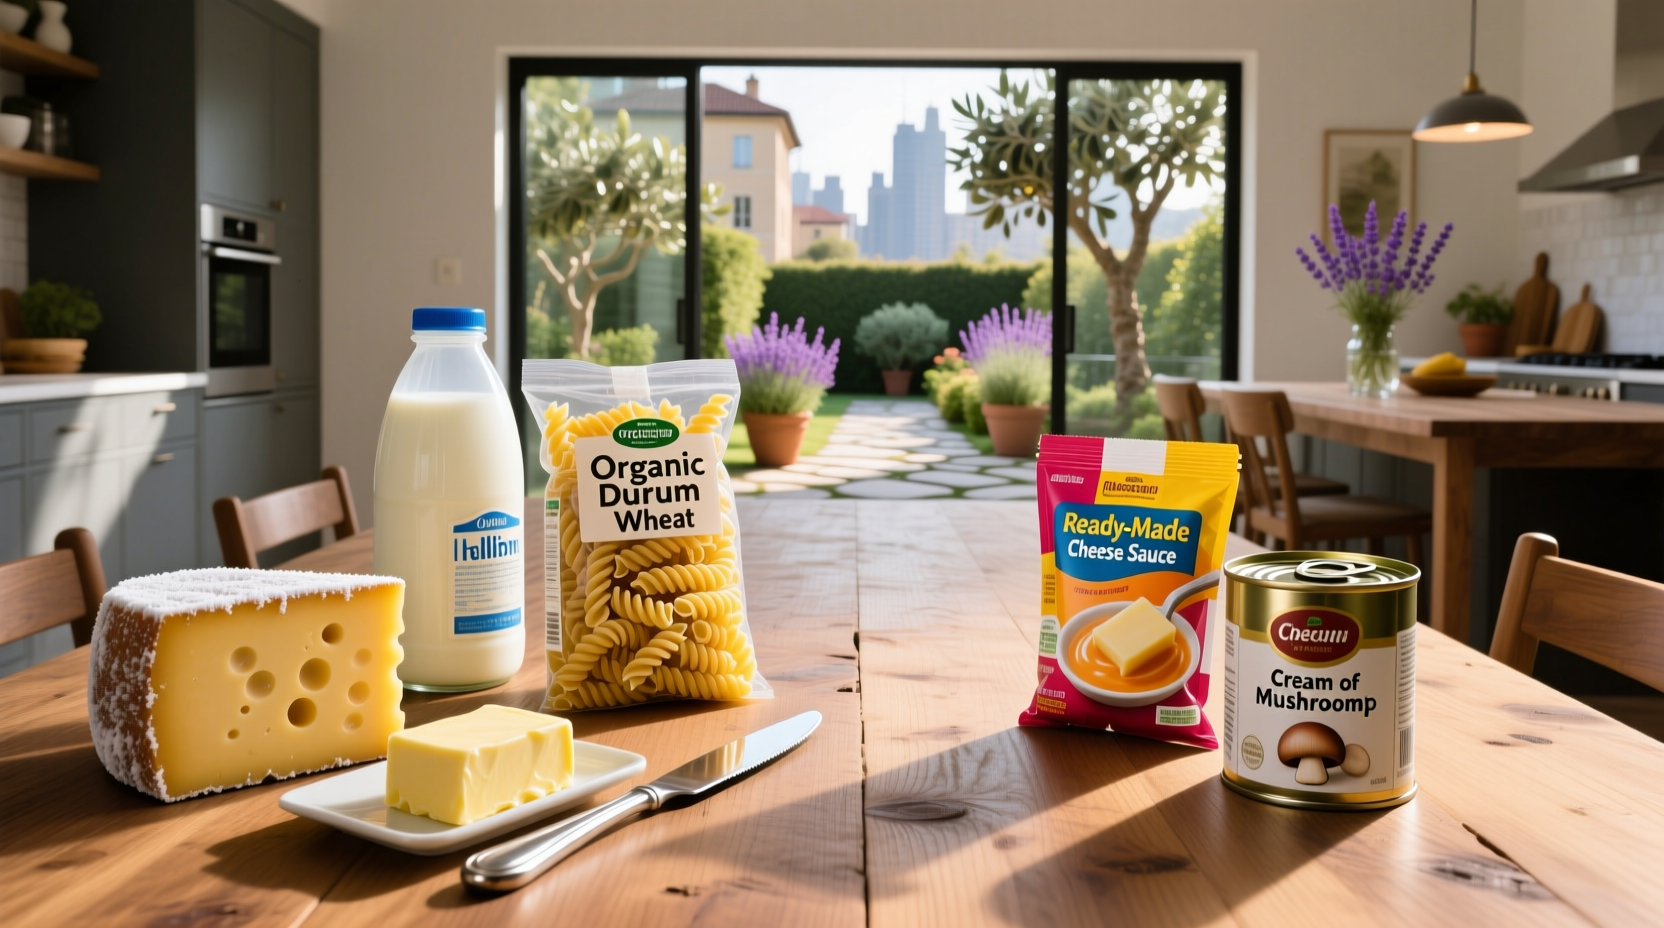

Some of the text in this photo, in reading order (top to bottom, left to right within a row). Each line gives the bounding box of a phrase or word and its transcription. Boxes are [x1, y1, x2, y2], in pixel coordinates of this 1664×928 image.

[590, 451, 706, 486] Organic
[599, 483, 700, 508] Durum
[614, 508, 695, 533] Wheat
[1063, 512, 1190, 543] Ready-Made
[1067, 539, 1177, 565] Cheese Sauce
[1271, 669, 1361, 691] Cream of
[1256, 686, 1377, 718] Mushroomp
